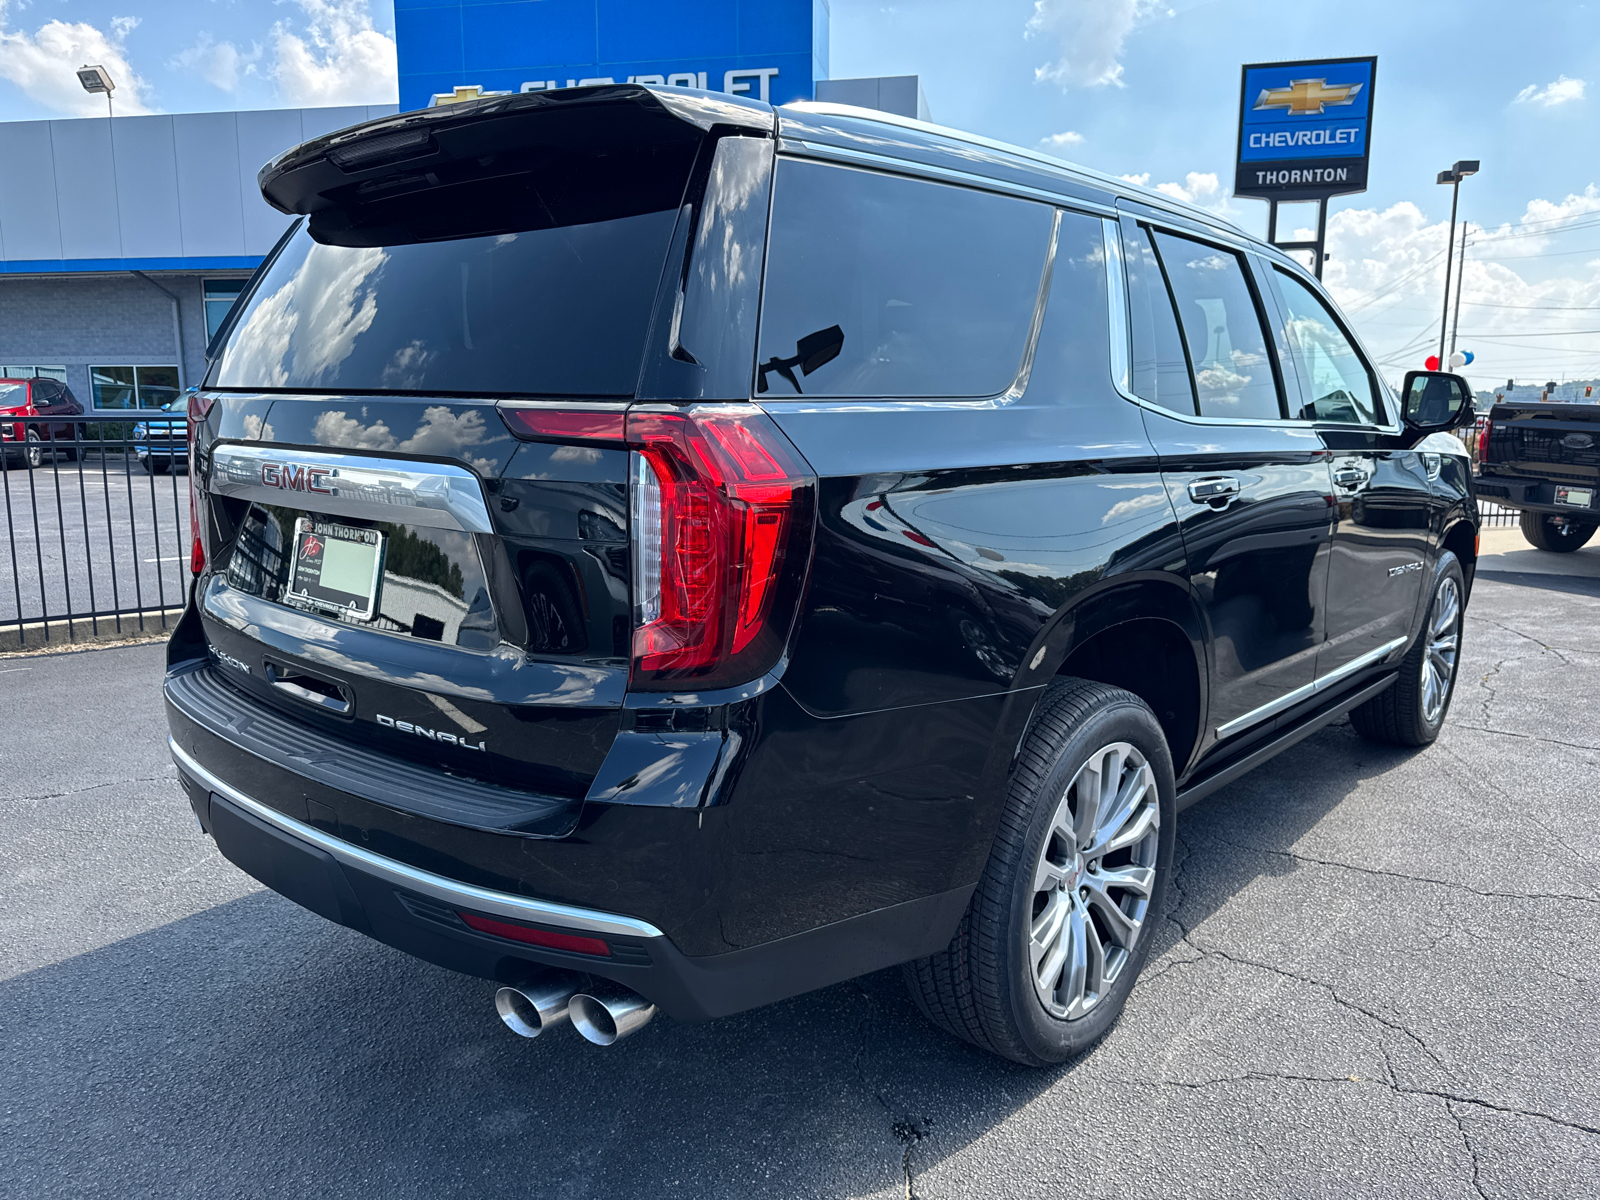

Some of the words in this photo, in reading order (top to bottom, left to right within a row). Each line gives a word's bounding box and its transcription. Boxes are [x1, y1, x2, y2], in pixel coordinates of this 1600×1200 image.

[1249, 129, 1359, 147] CHEVROLET
[1256, 168, 1347, 184] THORNTON
[262, 462, 339, 496] GMC
[314, 522, 333, 536] JOHN
[334, 526, 376, 543] THORNTON
[208, 644, 251, 674] YUKON
[376, 713, 487, 752] DENALI
